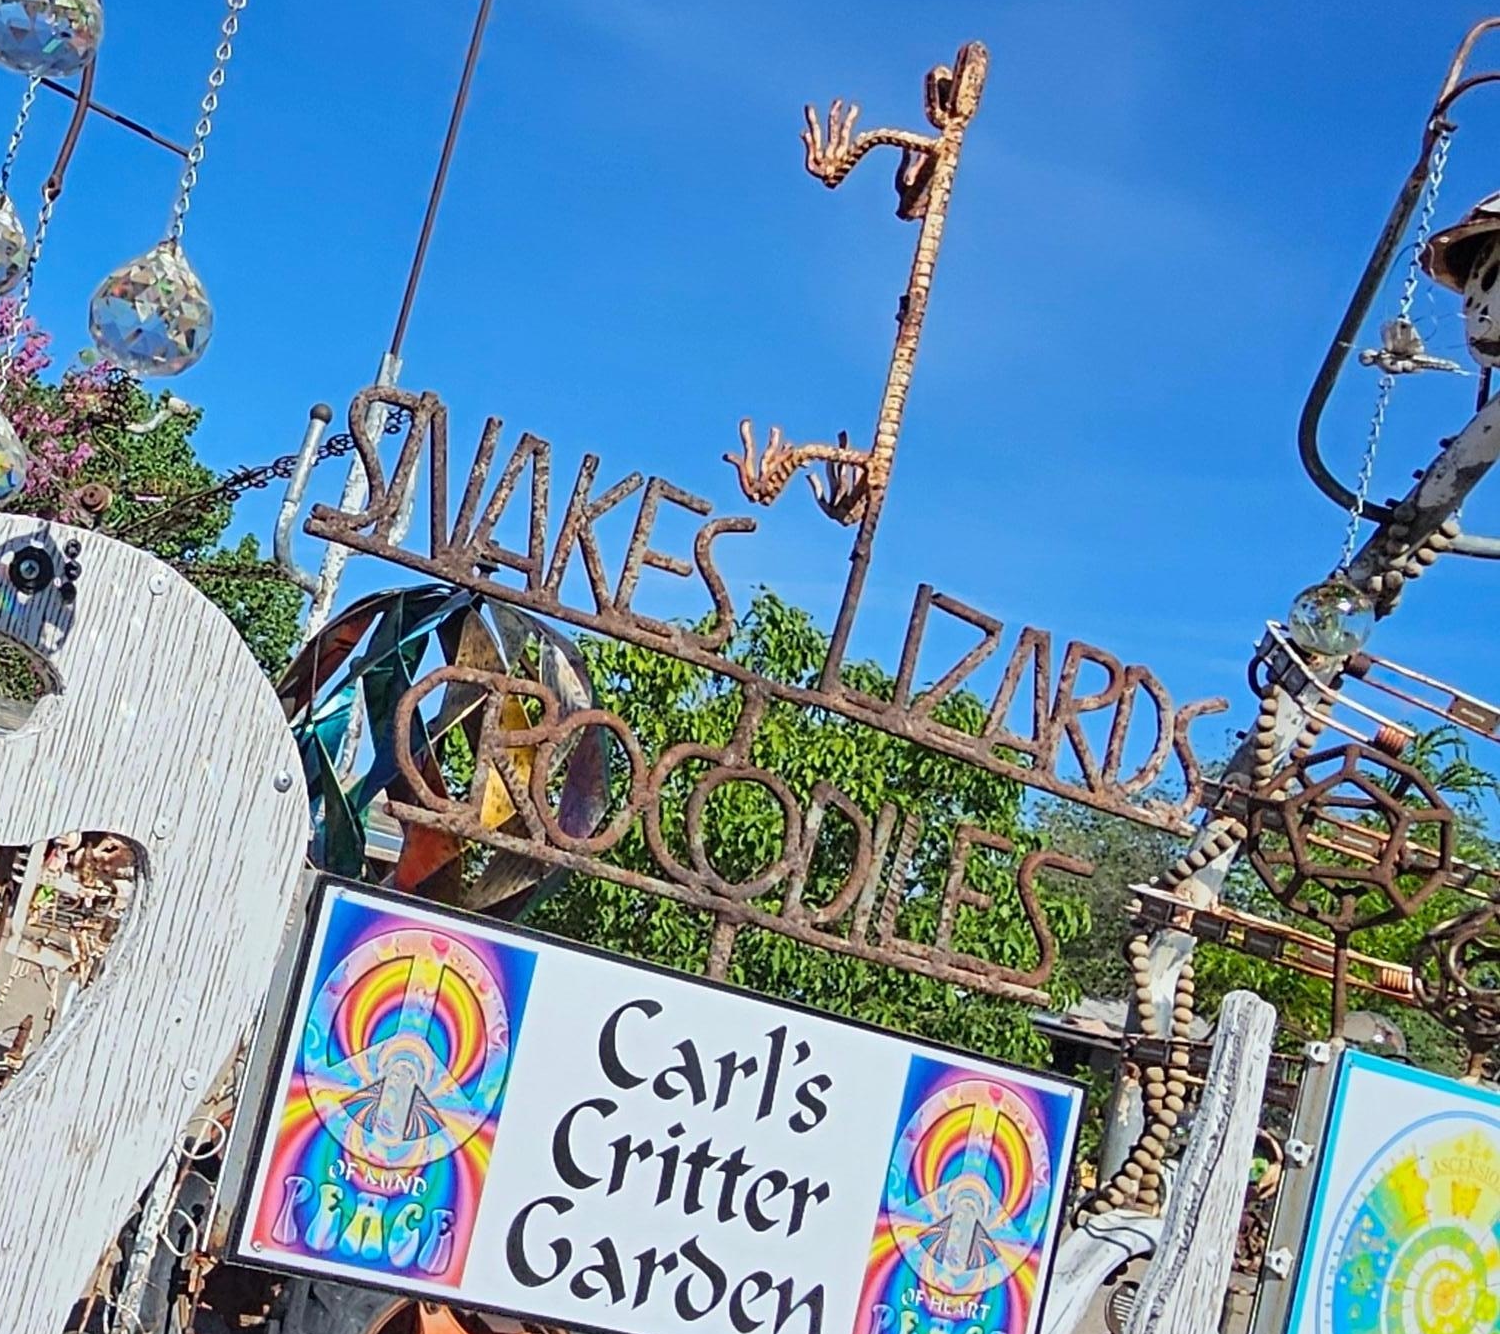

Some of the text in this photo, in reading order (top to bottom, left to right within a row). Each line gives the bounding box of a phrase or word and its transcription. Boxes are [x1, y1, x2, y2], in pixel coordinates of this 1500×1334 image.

[306, 387, 758, 652] SNAKES
[597, 998, 832, 1134] Carl's
[271, 1175, 455, 1275] PEACE
[328, 1159, 359, 1181] OF
[551, 1098, 831, 1240] Critter
[901, 1288, 991, 1321] OF HEART
